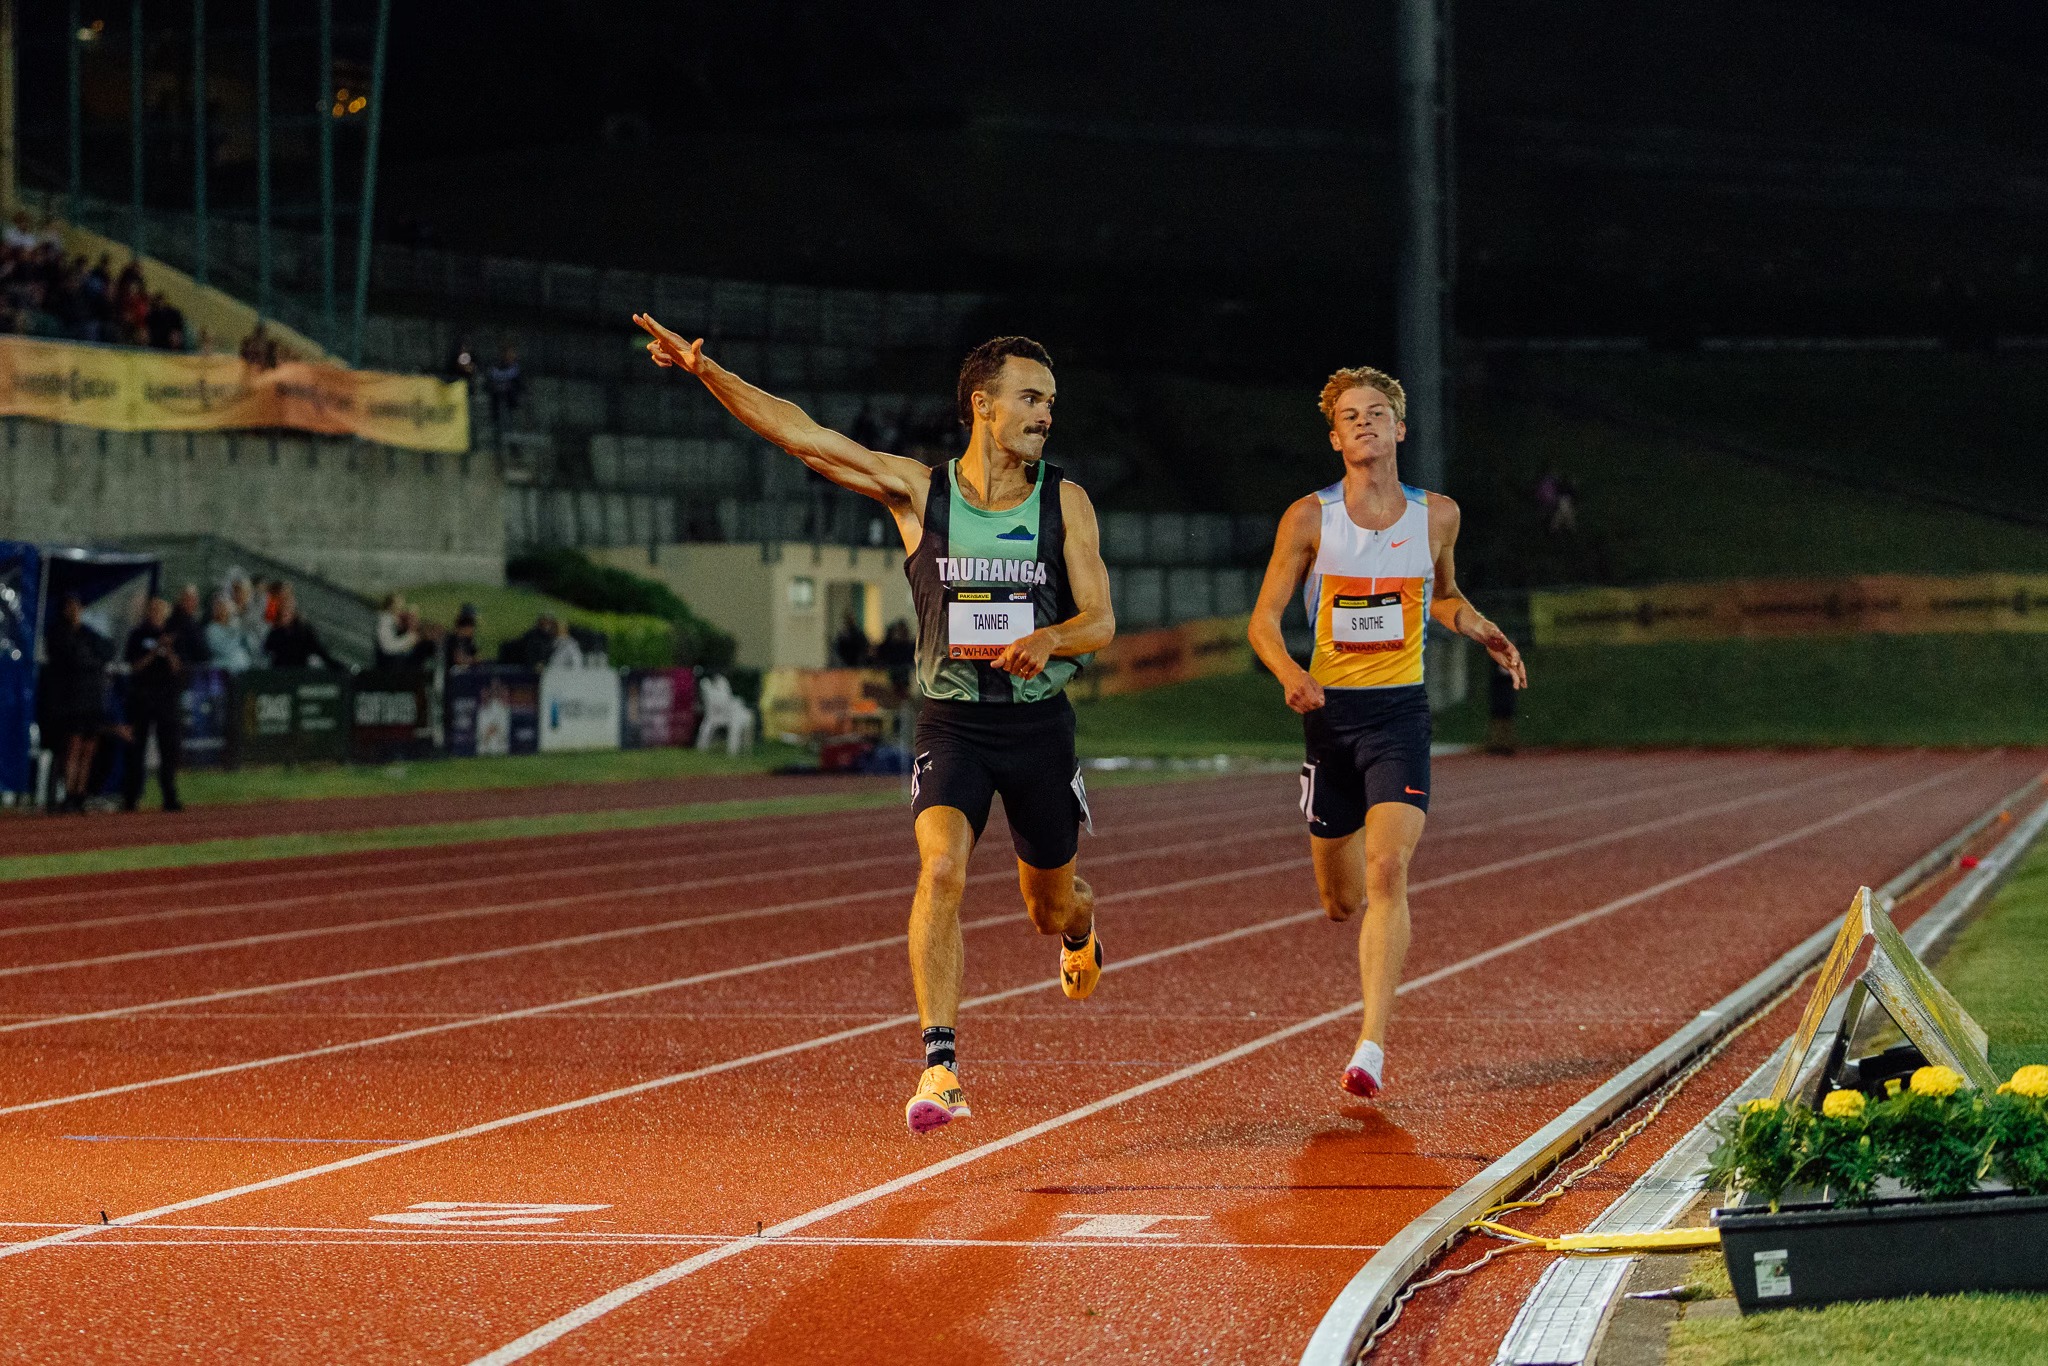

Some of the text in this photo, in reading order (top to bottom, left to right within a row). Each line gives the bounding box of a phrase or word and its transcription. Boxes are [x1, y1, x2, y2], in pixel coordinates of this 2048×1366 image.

[936, 557, 1047, 585] TAURANGA
[973, 614, 1009, 630] TANNER
[1352, 616, 1384, 631] S RUTHE
